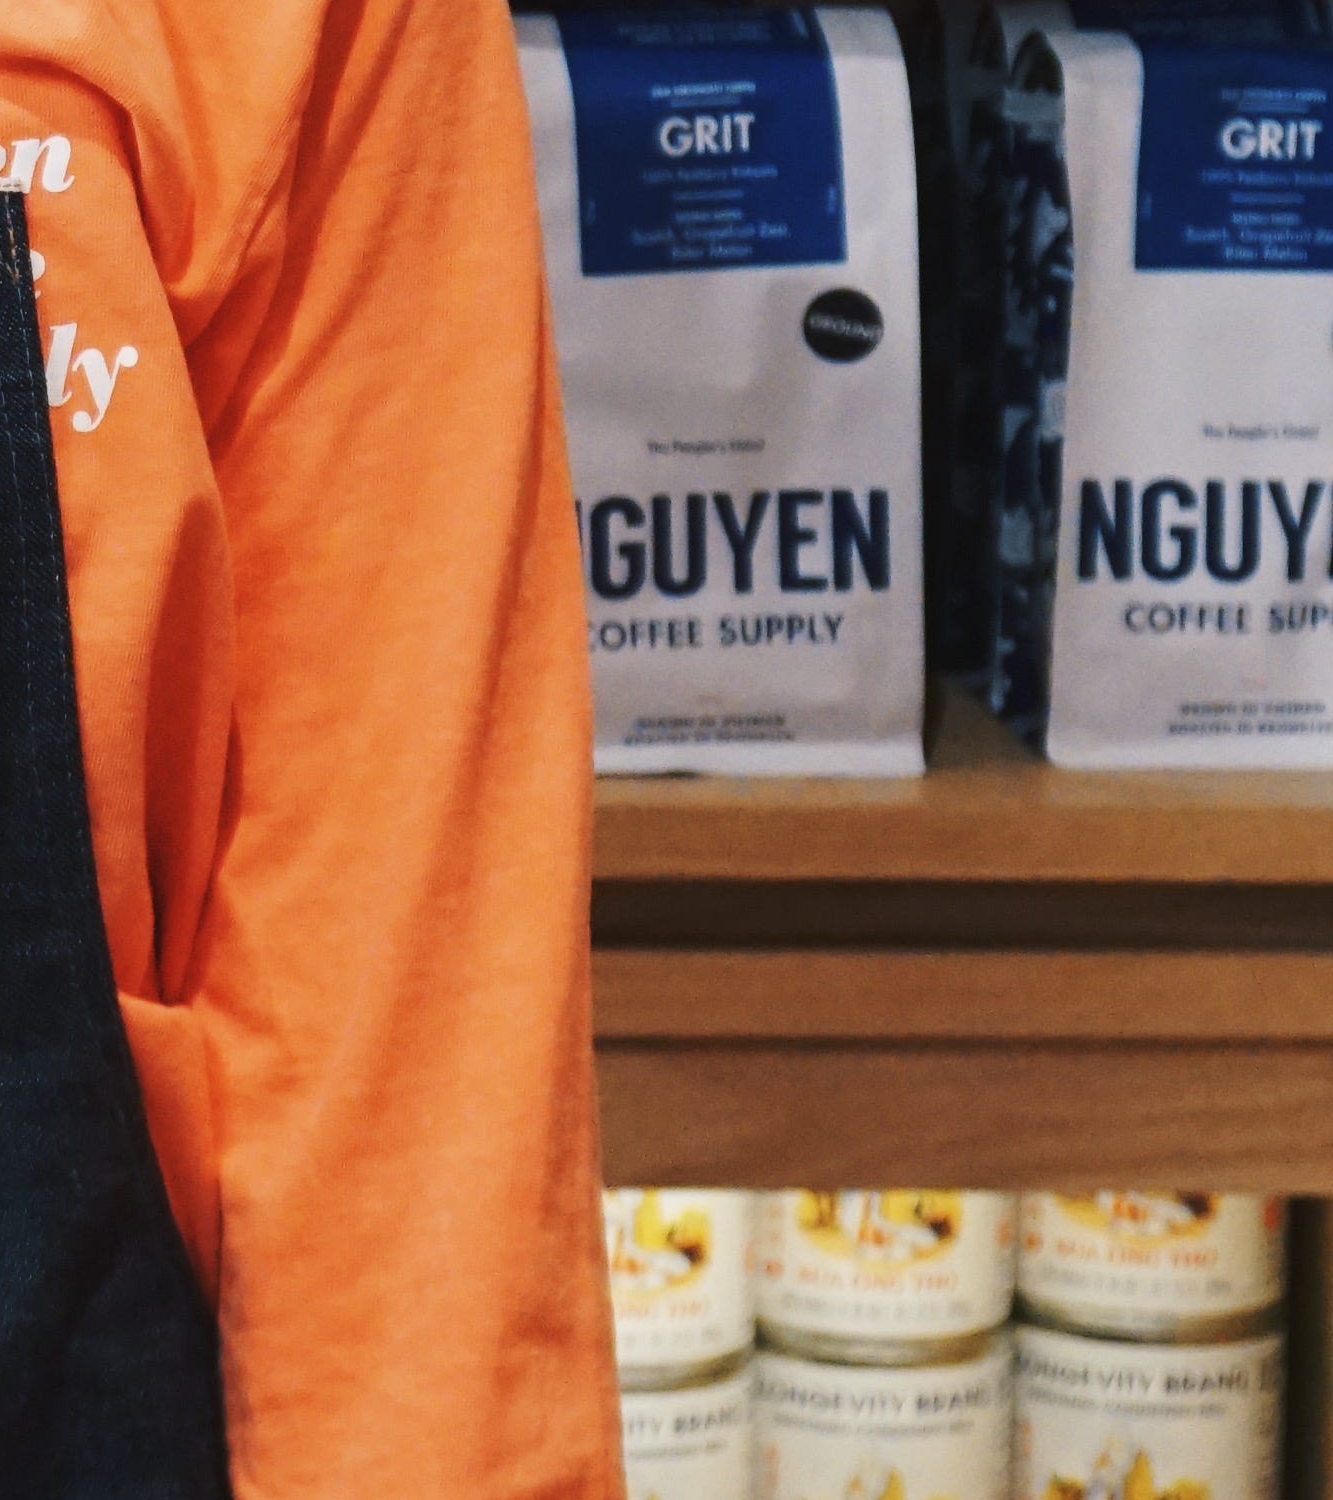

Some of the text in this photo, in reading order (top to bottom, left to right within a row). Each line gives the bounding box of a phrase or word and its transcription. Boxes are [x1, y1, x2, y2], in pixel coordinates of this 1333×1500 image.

[658, 112, 756, 158] GRIT
[1220, 115, 1324, 161] GRIT
[575, 488, 891, 602] GUYEN
[1077, 477, 1333, 583] NGUY
[718, 613, 844, 647] SUPPLY
[1123, 603, 1333, 634] COFFEE SUP
